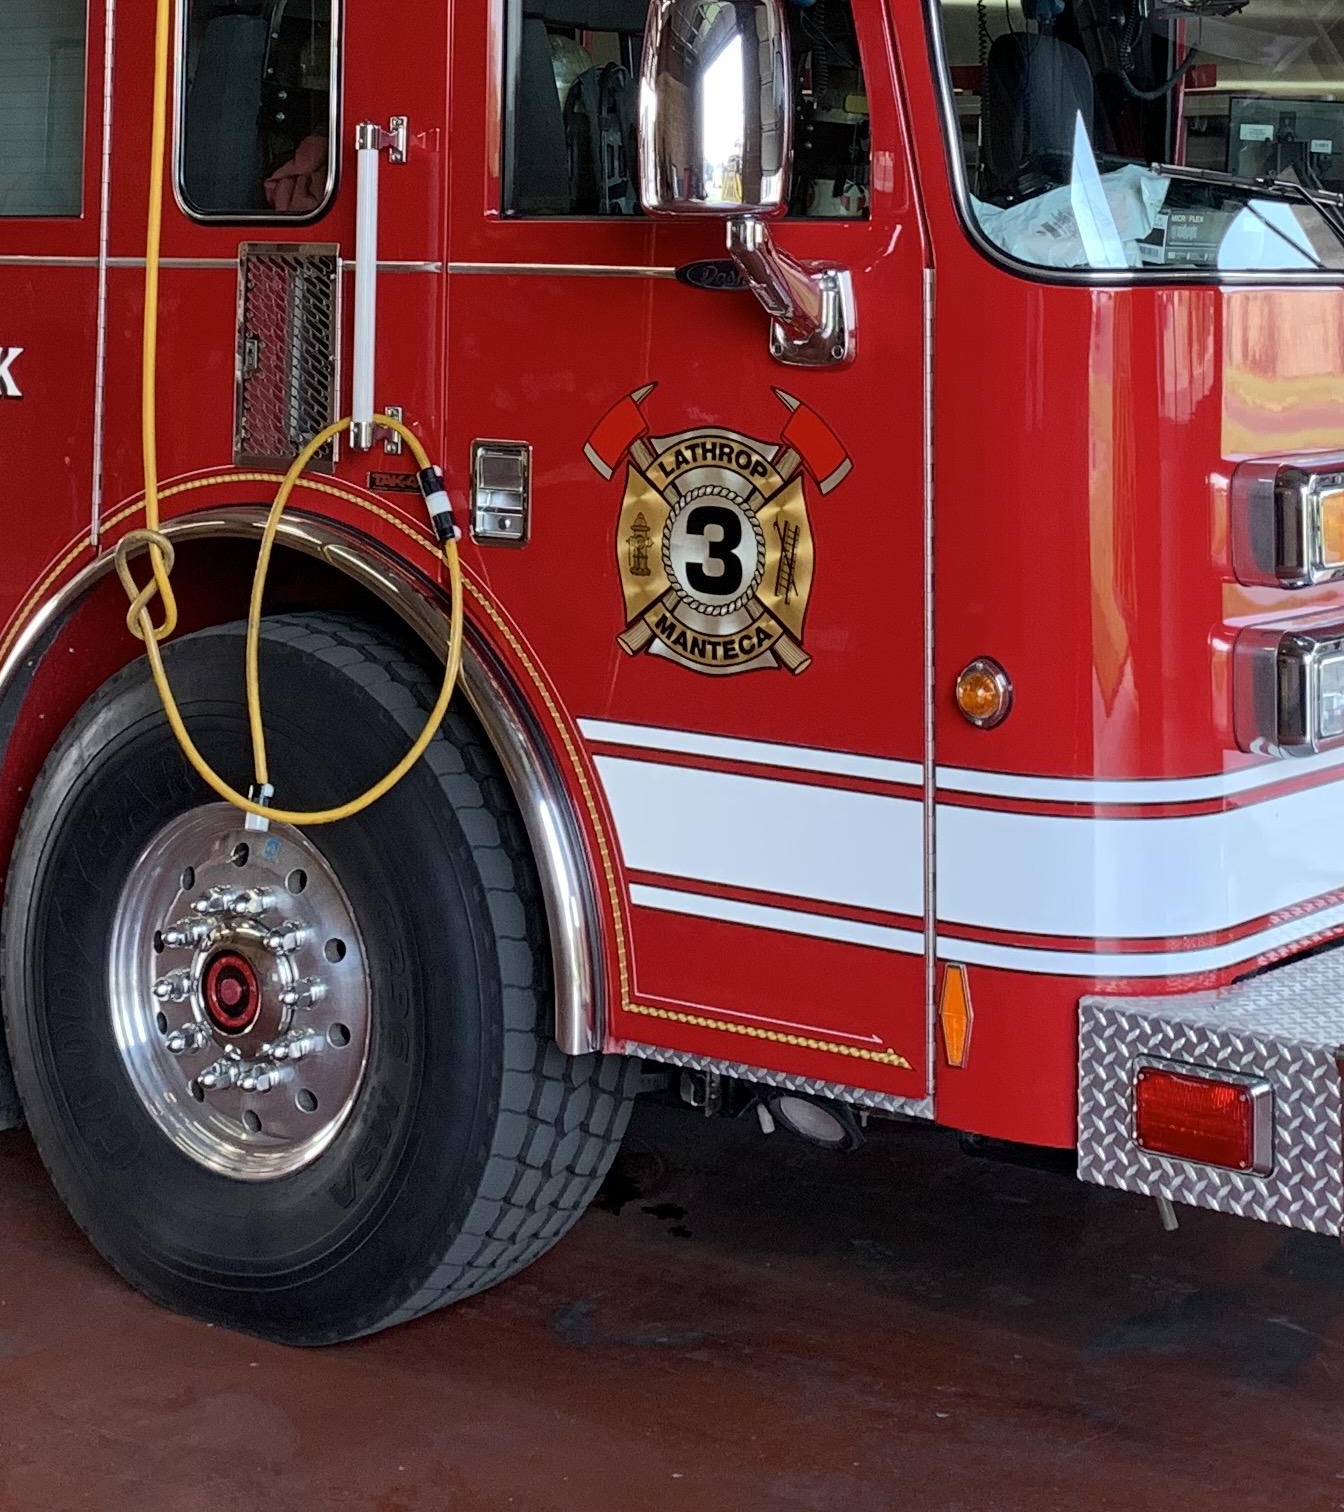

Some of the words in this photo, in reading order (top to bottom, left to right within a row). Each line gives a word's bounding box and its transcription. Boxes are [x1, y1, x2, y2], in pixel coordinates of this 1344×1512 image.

[1171, 215, 1204, 224] MICRFLEX
[659, 442, 768, 481] LATHROP
[685, 506, 743, 596] 3
[655, 615, 774, 660] MANTECA
